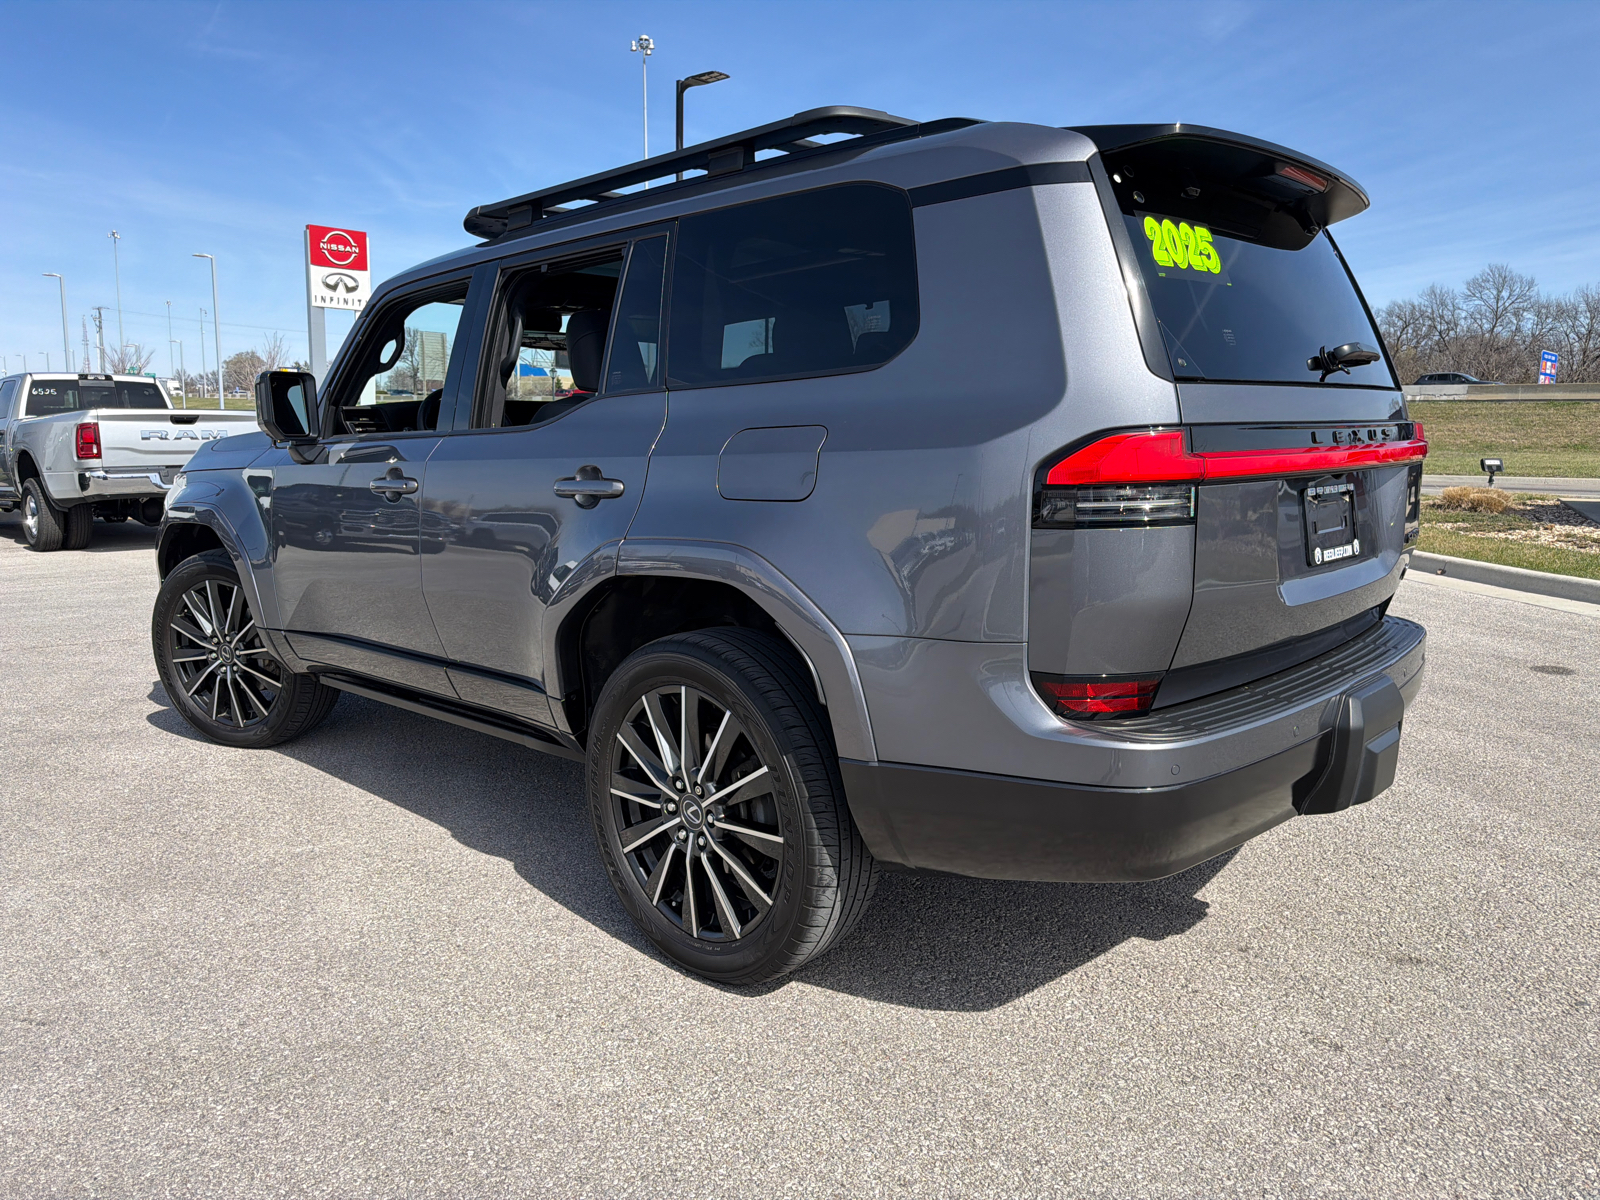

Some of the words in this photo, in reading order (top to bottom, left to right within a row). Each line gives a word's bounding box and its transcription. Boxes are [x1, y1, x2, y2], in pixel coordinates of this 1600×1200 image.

[320, 243, 358, 254] NISSAN
[1144, 216, 1221, 274] 2025
[141, 429, 228, 440] RAM
[1311, 428, 1390, 445] LEXUS
[768, 764, 795, 904] DUNLOP
